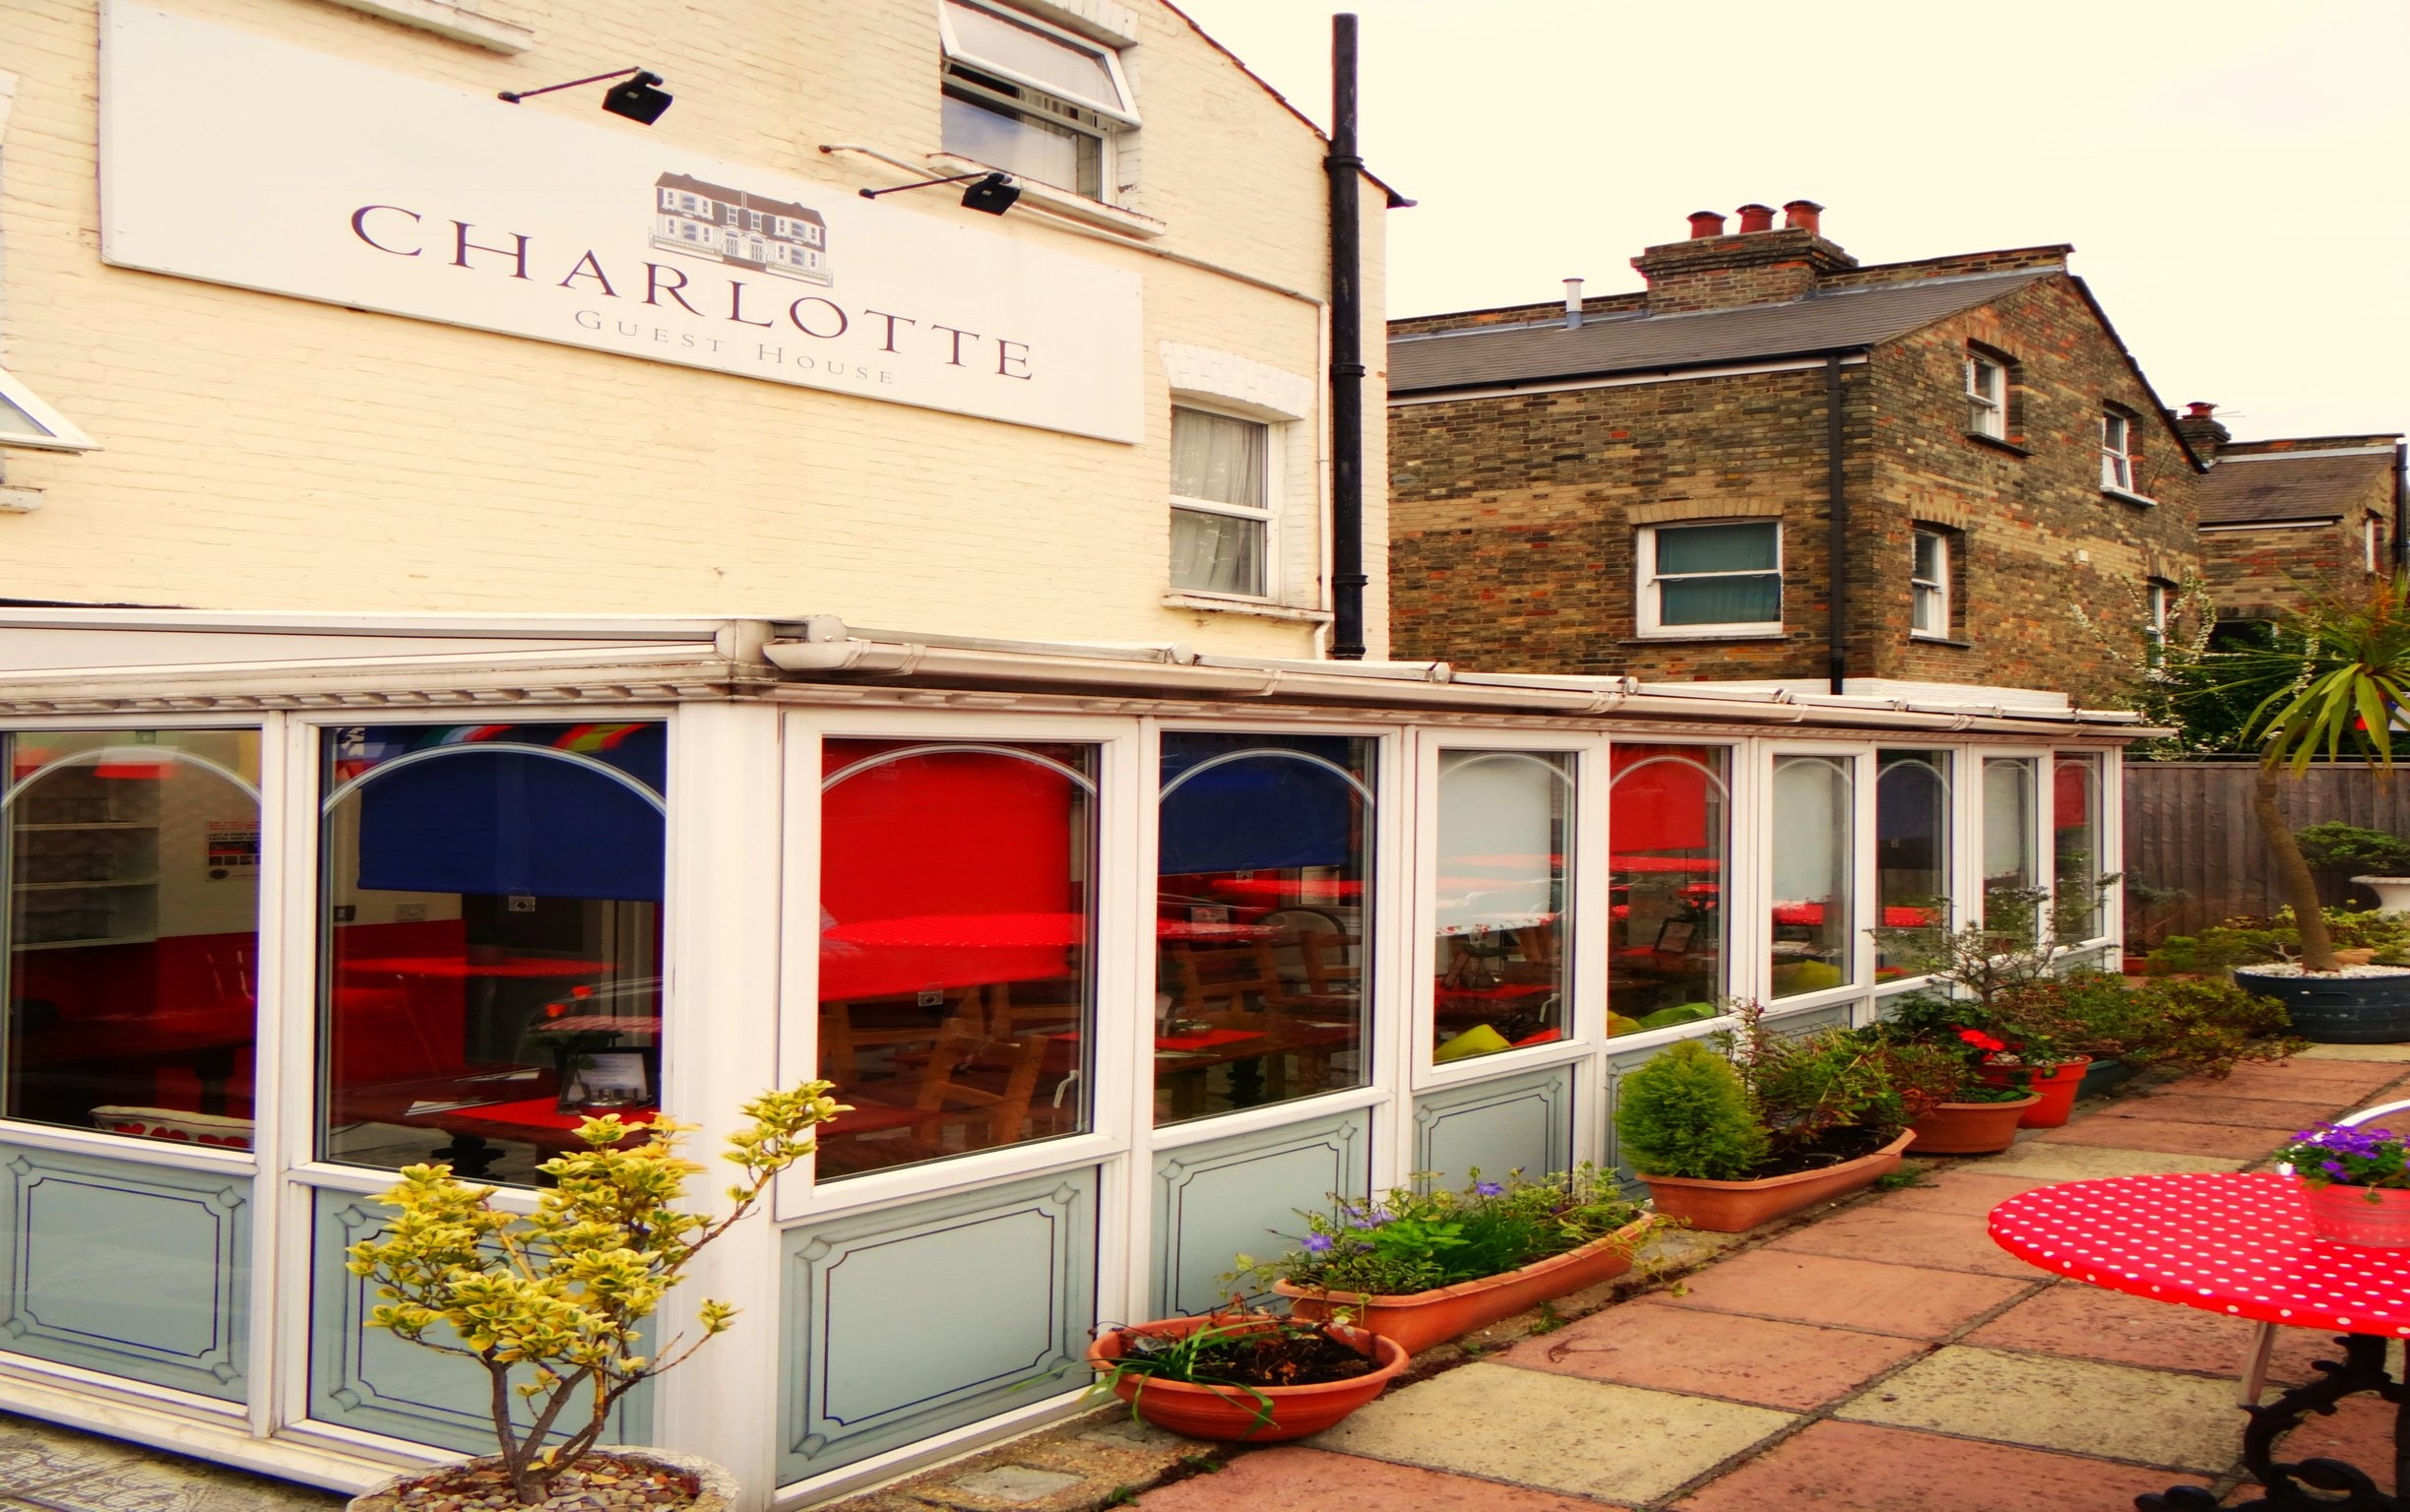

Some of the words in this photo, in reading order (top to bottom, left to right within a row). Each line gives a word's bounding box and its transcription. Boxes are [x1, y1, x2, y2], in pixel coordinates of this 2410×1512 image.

[350, 205, 1033, 381] CHARLOTTE
[574, 309, 726, 353] GUEST
[757, 342, 895, 385] HOUSE
